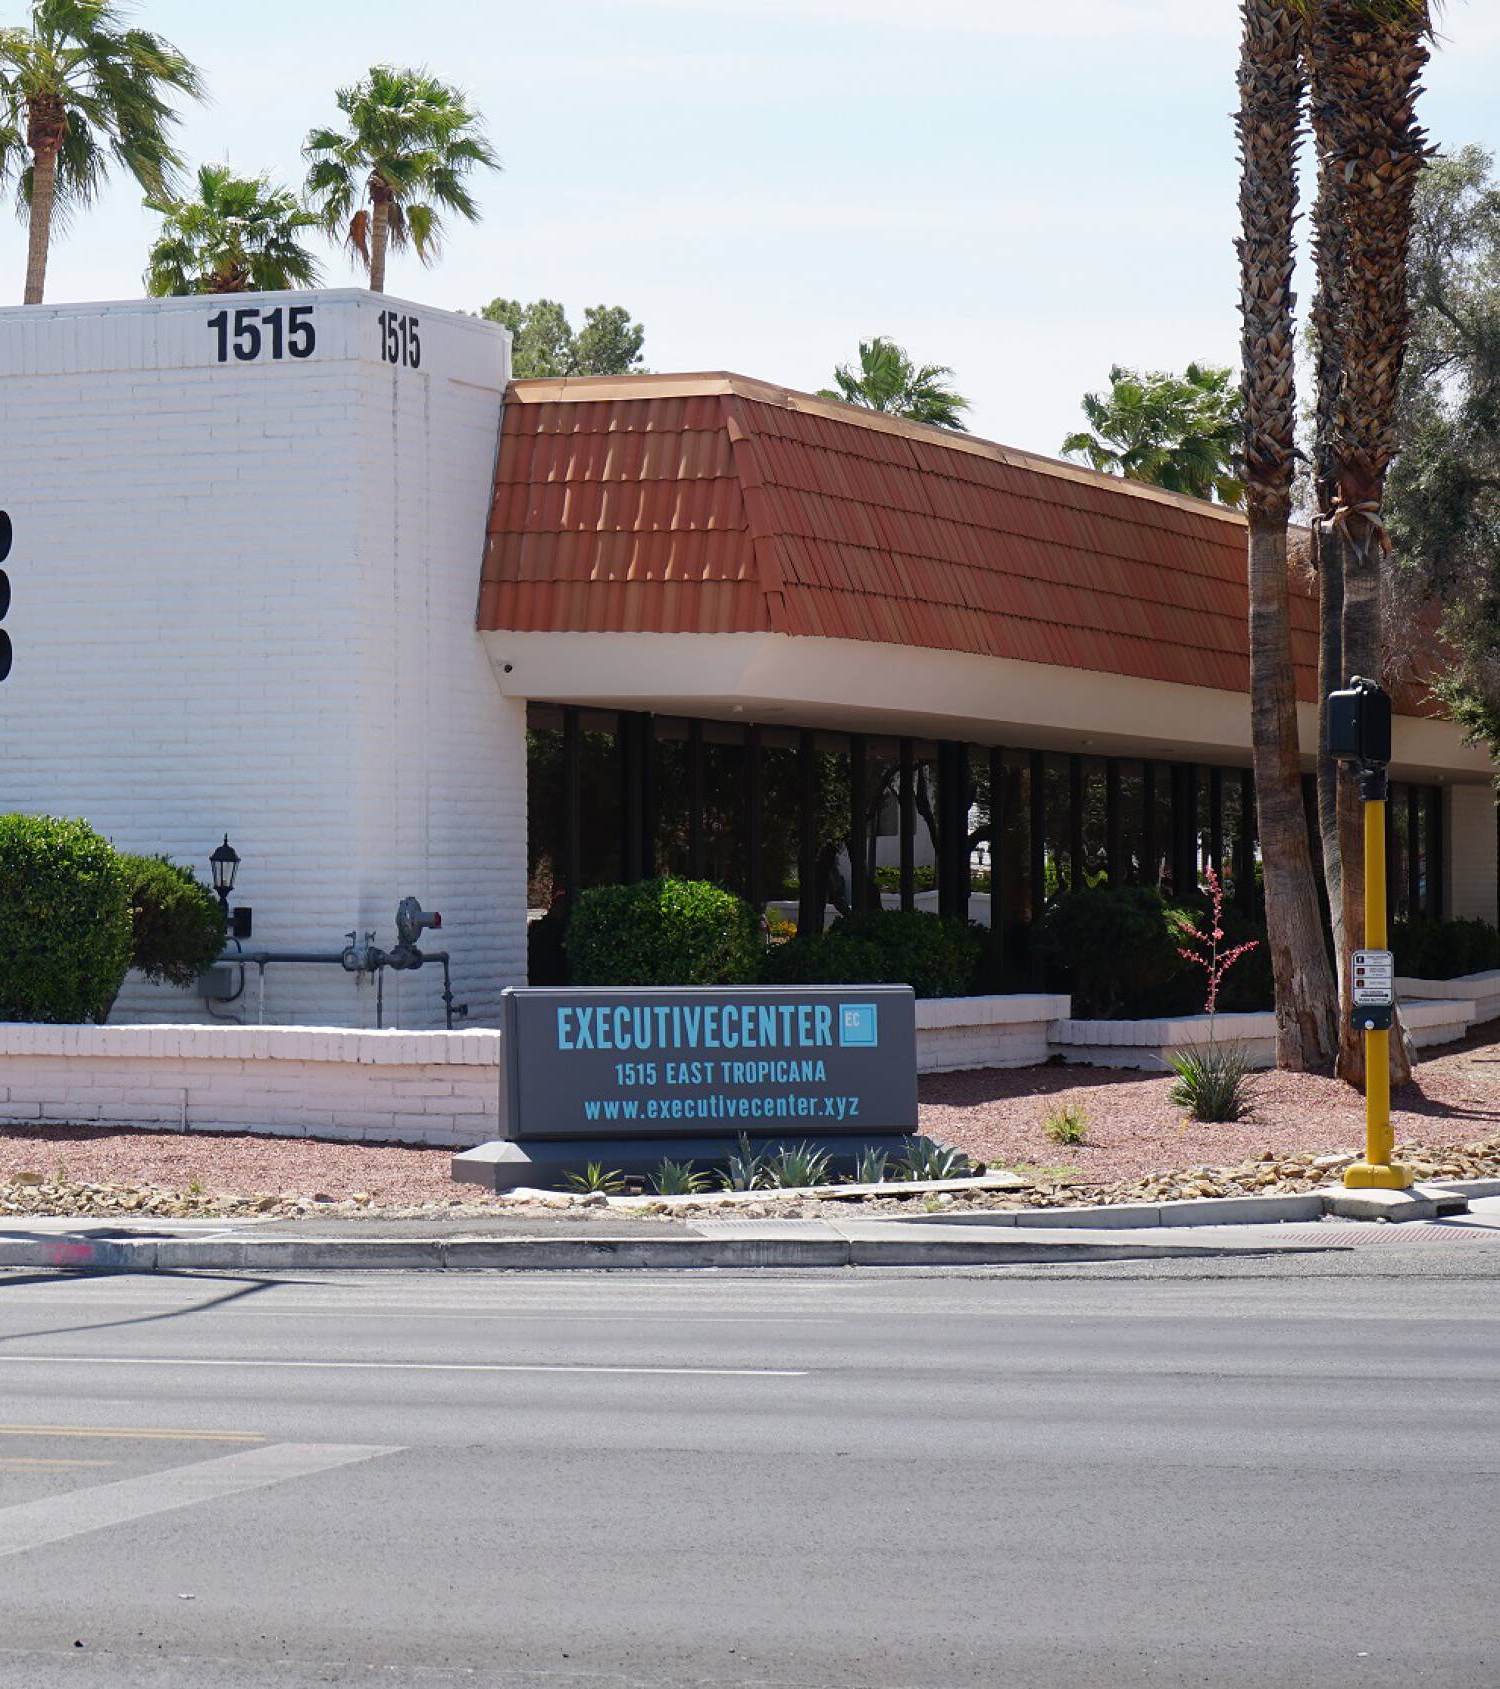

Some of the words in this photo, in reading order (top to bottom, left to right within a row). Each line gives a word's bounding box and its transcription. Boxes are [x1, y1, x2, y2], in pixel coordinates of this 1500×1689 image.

[207, 305, 316, 362] 1515
[378, 310, 421, 369] 1515
[557, 1005, 833, 1050] EXECUTIVECENTER
[845, 1010, 860, 1027] EC
[615, 1063, 657, 1086] 1515
[666, 1061, 714, 1085] EAST
[721, 1059, 827, 1084] TROPICANA
[584, 1093, 860, 1120] www.executivecenter.xyz
